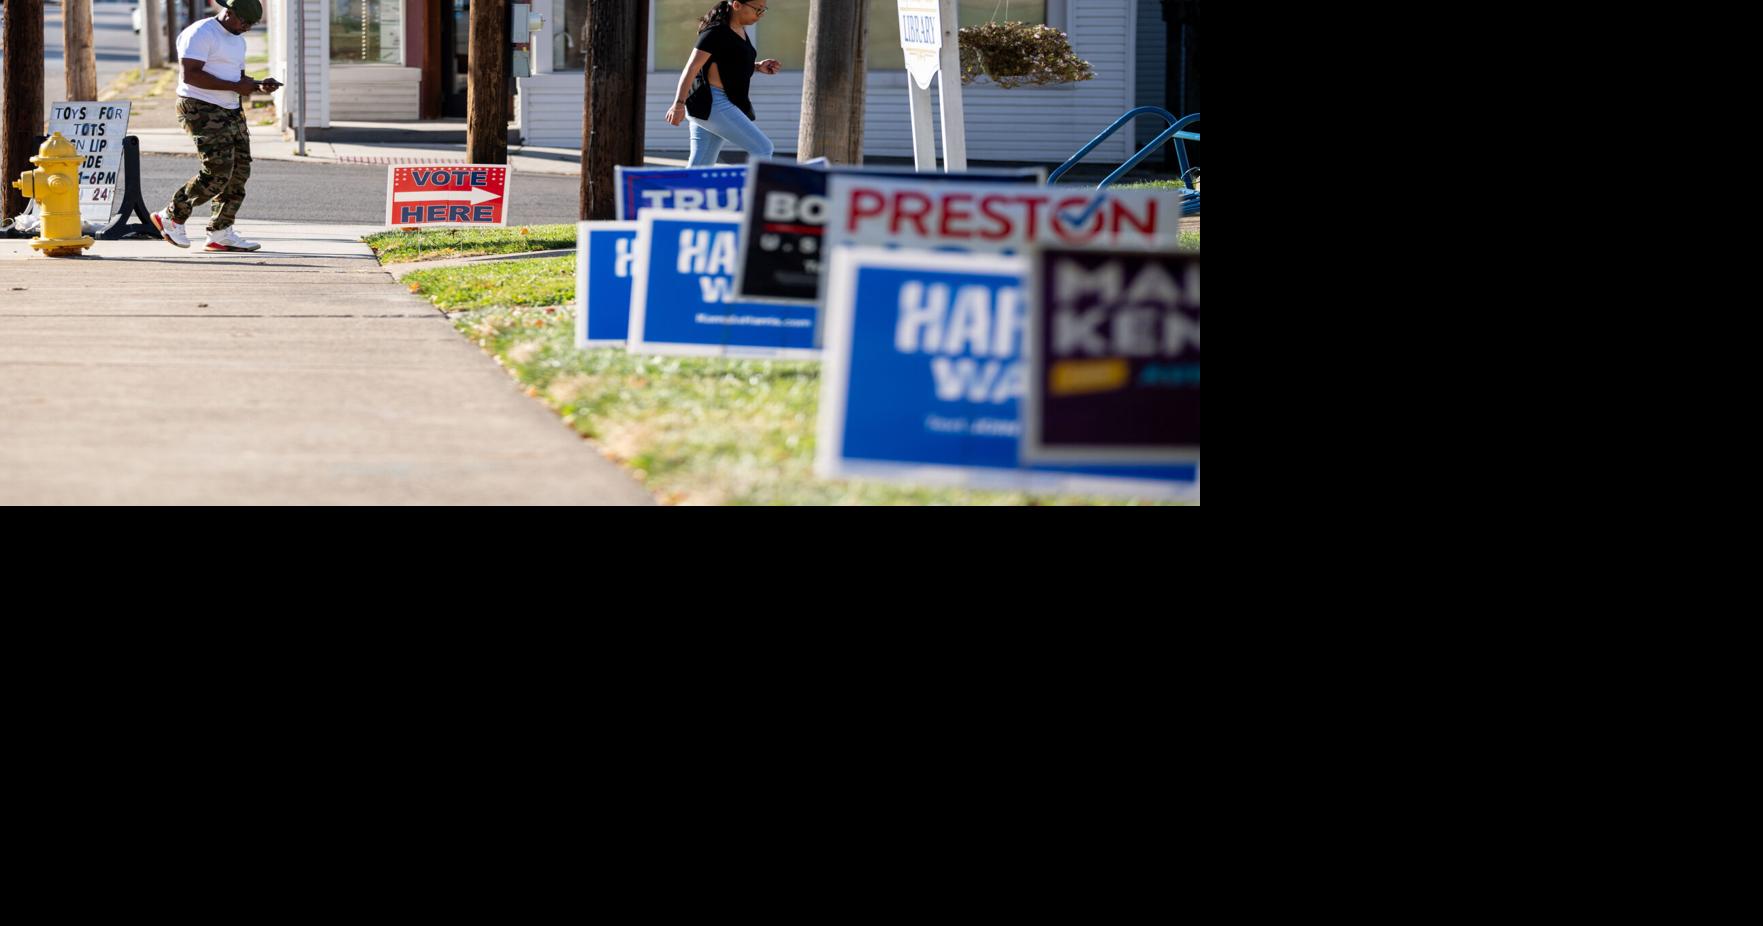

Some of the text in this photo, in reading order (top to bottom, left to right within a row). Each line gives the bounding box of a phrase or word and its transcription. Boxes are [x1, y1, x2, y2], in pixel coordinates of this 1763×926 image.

[902, 15, 936, 45] LIBRARY
[55, 106, 123, 120] TOYS FOR
[73, 122, 106, 136] TOTS
[89, 139, 107, 153] UP
[411, 170, 488, 187] VOTE
[641, 187, 747, 212] TRU
[400, 205, 495, 224] HERE
[845, 187, 1159, 244] PRESTON
